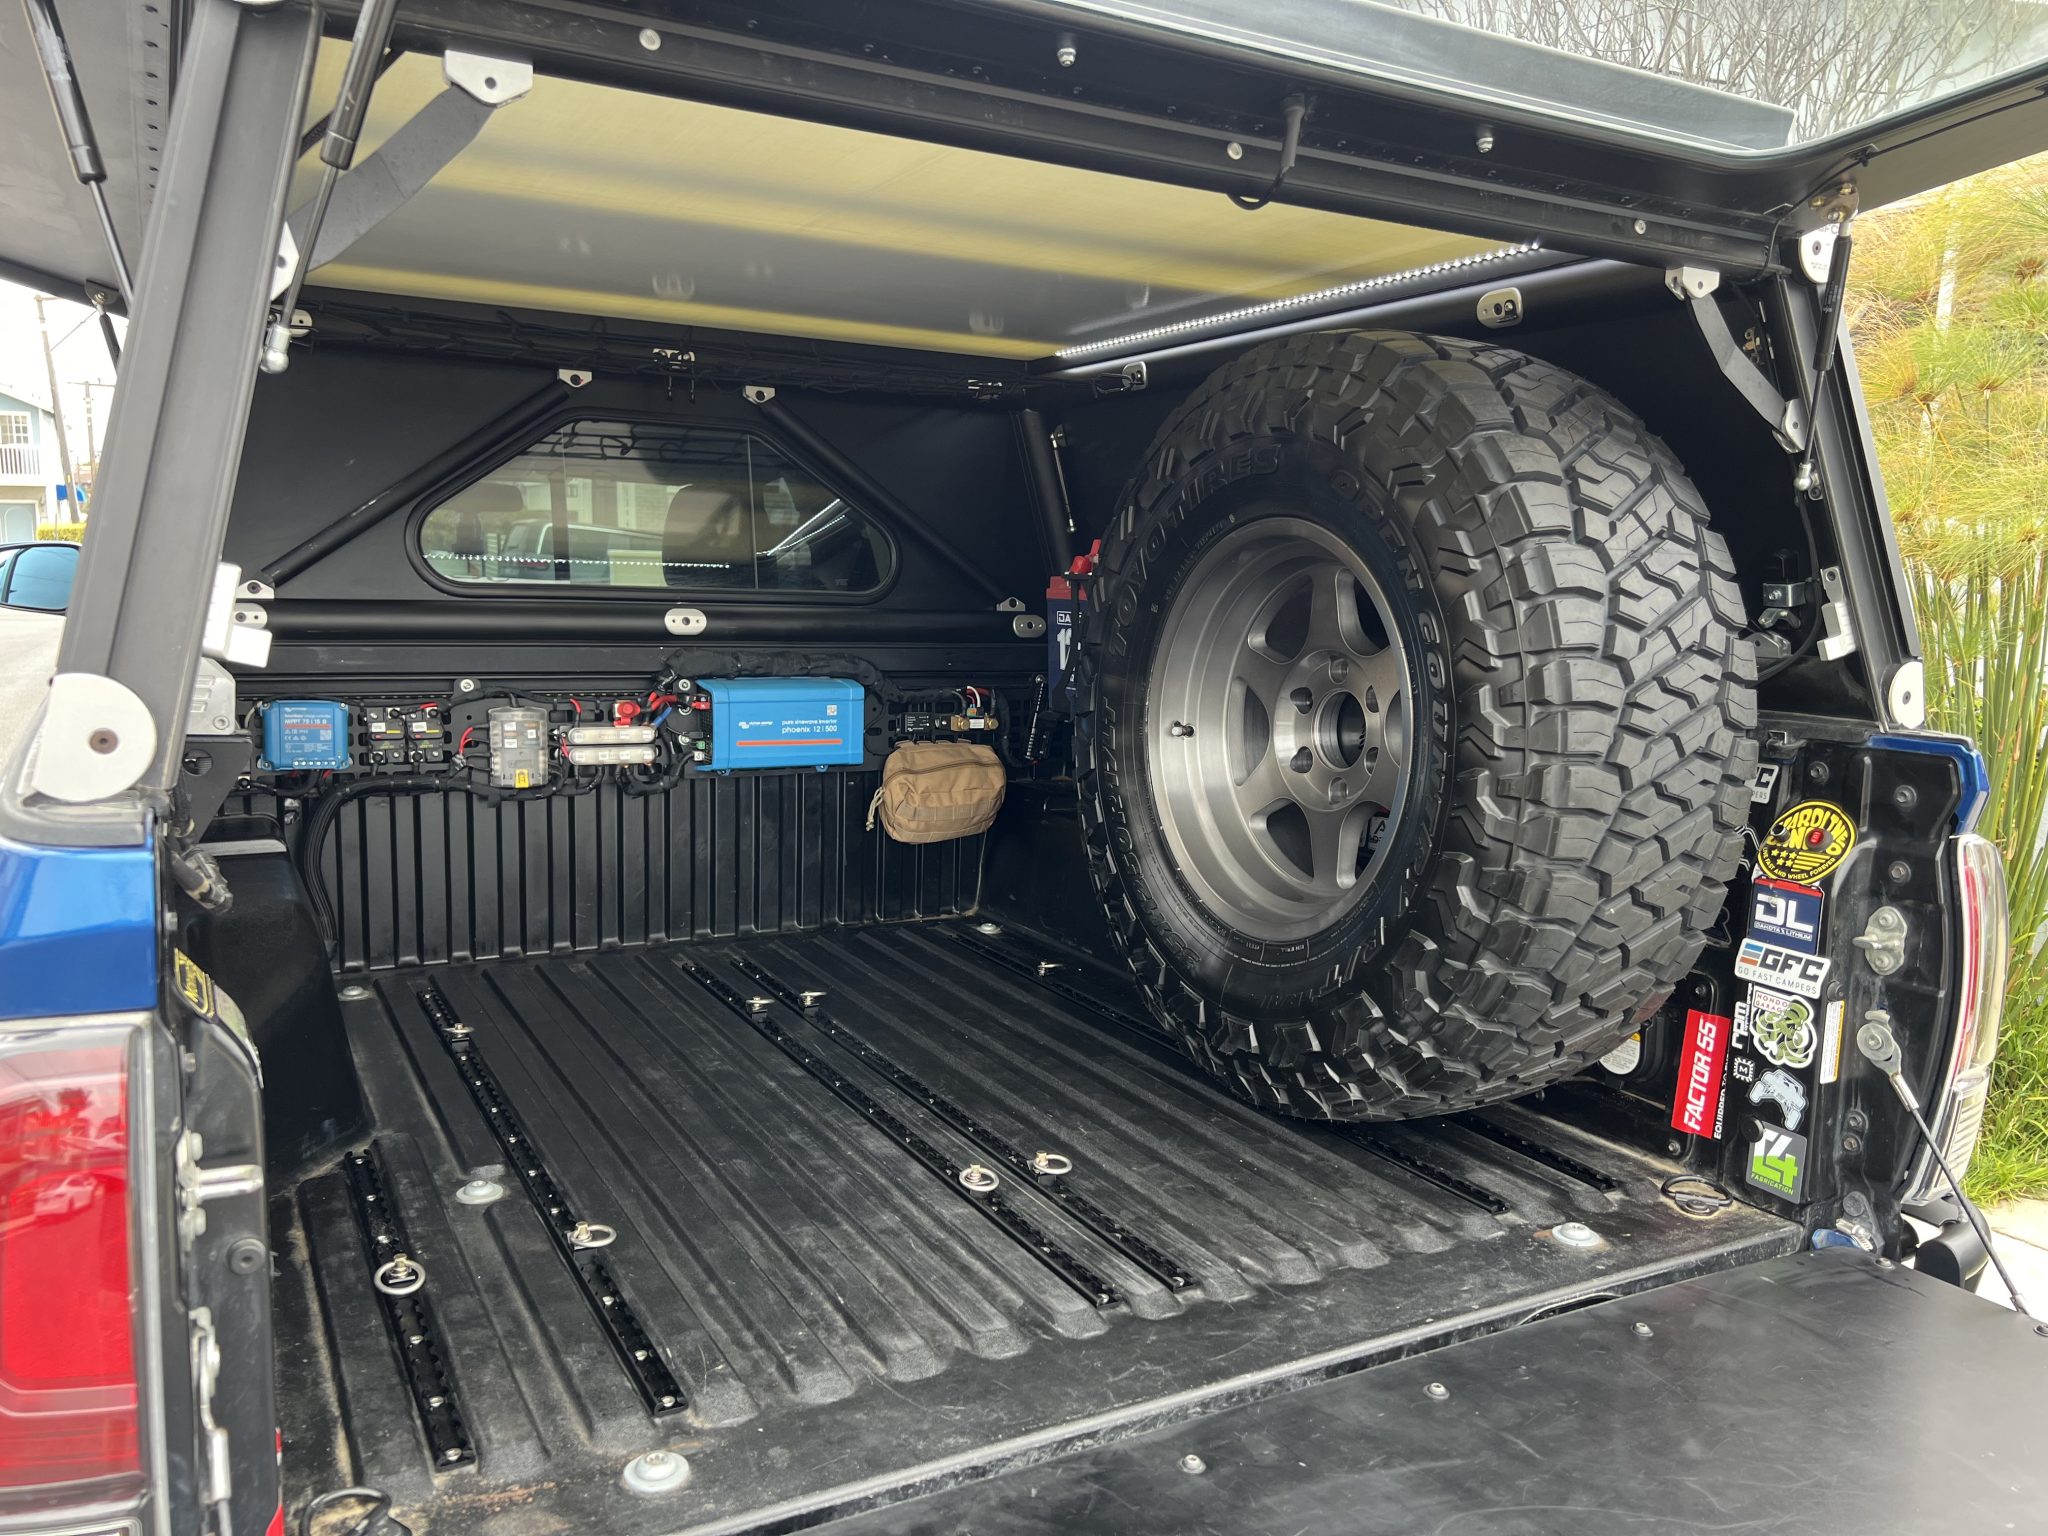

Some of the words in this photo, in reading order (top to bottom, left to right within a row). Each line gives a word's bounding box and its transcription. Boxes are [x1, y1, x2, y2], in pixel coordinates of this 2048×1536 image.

[781, 725, 811, 735] phoenix
[1764, 857, 1776, 871] FAST
[1773, 869, 1787, 878] AND
[1809, 857, 1836, 877] FOREVER
[1754, 893, 1814, 933] DL
[1755, 922, 1780, 934] DAKOTA
[1785, 929, 1812, 941] LITHIUM
[1758, 947, 1825, 983] GFC
[1738, 966, 1750, 976] GO
[1752, 971, 1773, 981] FAST
[1775, 976, 1818, 995] CAMPERS
[1756, 993, 1788, 1007] HONDO
[1683, 1051, 1712, 1131] FACTOR
[1751, 1172, 1794, 1196] FABRICATION
